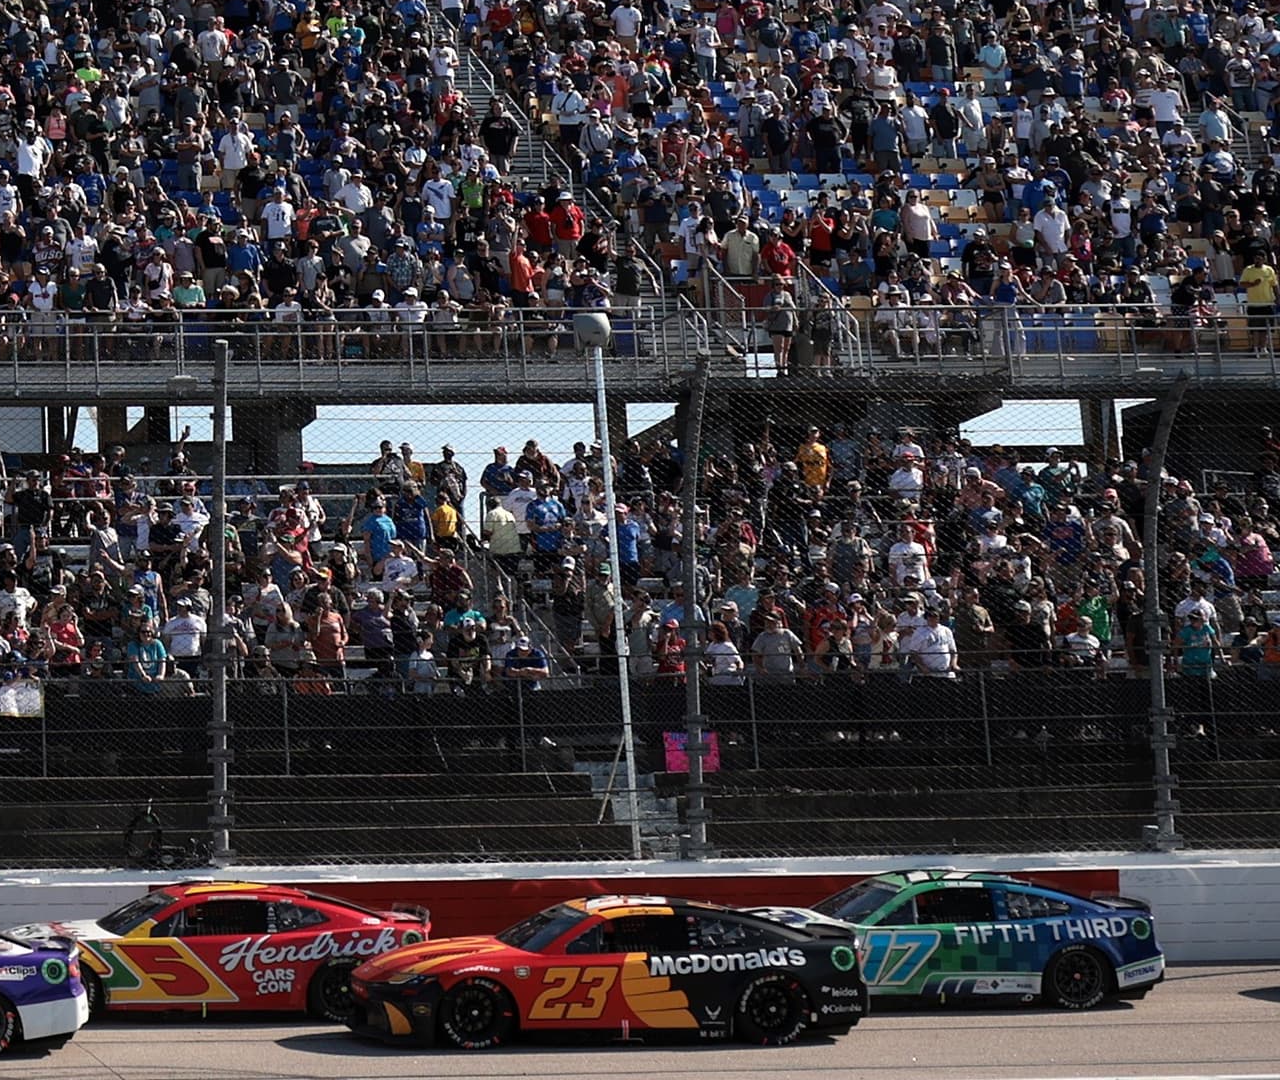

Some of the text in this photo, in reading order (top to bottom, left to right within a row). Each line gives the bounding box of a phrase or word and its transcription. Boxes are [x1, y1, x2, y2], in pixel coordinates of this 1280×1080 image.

[953, 916, 1129, 946] FIFTH THIRD
[116, 944, 210, 997] 5
[218, 928, 403, 974] Hendrick
[650, 945, 808, 977] McDonald's
[862, 932, 940, 984] 17
[252, 968, 296, 984] CARS
[528, 967, 621, 1019] 23
[831, 986, 859, 997] leidos
